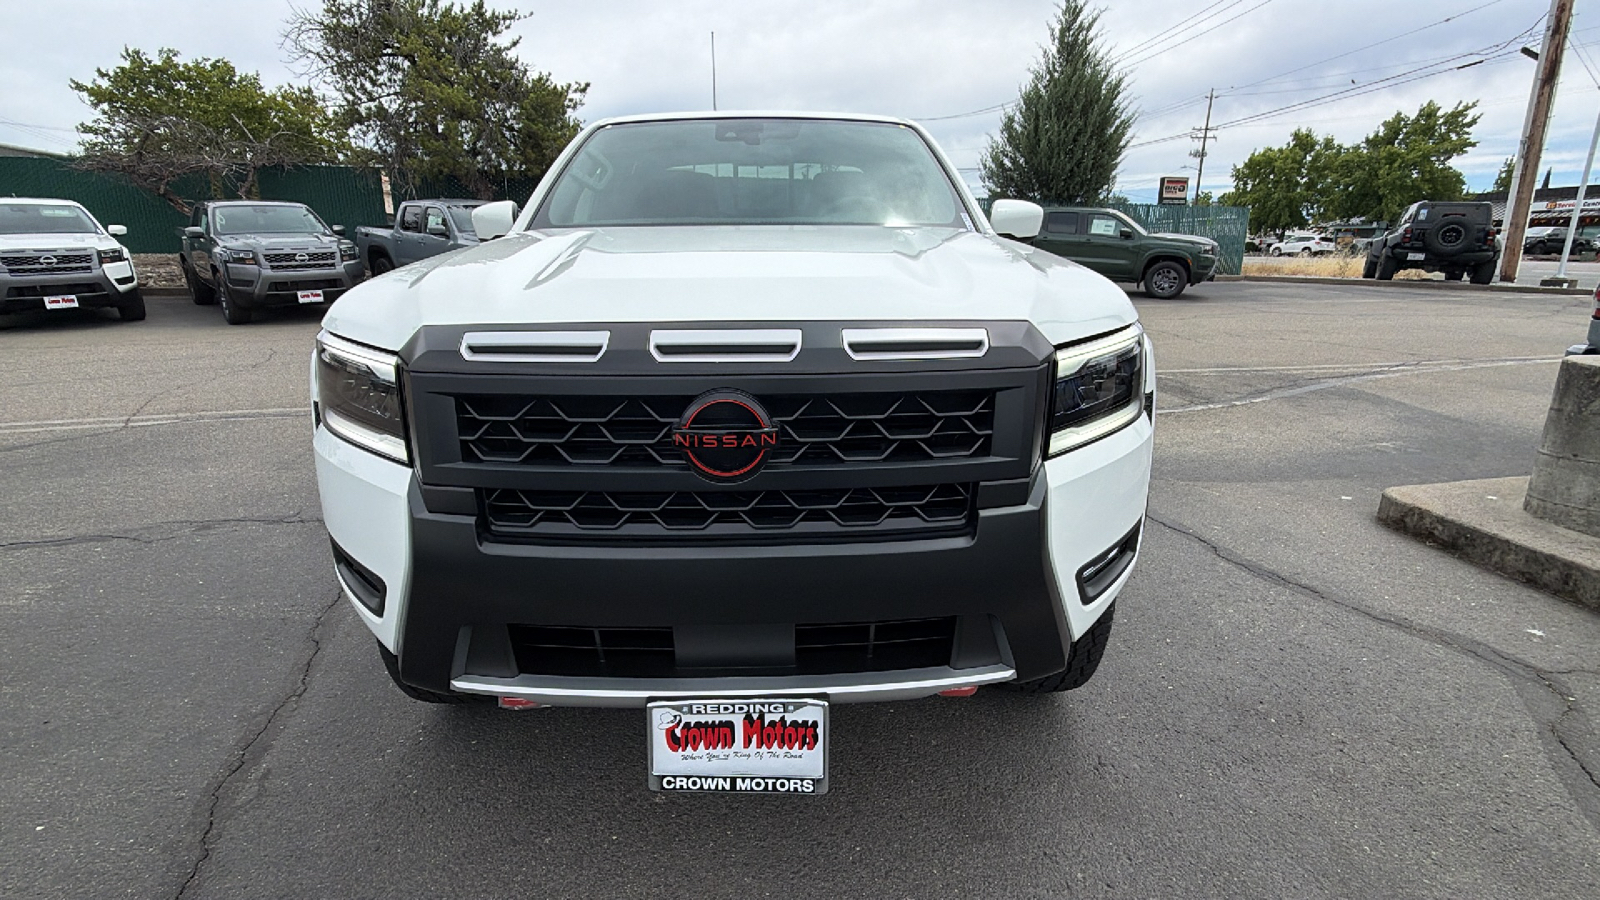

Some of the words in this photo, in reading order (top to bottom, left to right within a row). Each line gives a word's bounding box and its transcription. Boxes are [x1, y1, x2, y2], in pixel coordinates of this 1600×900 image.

[675, 433, 776, 447] NISSAN
[692, 704, 784, 714] REDDING
[664, 715, 735, 752] Crown
[743, 713, 819, 751] Motors
[733, 752, 751, 760] King
[754, 752, 765, 760] Of
[662, 777, 731, 791] CROWN
[736, 778, 814, 792] MOTORS
